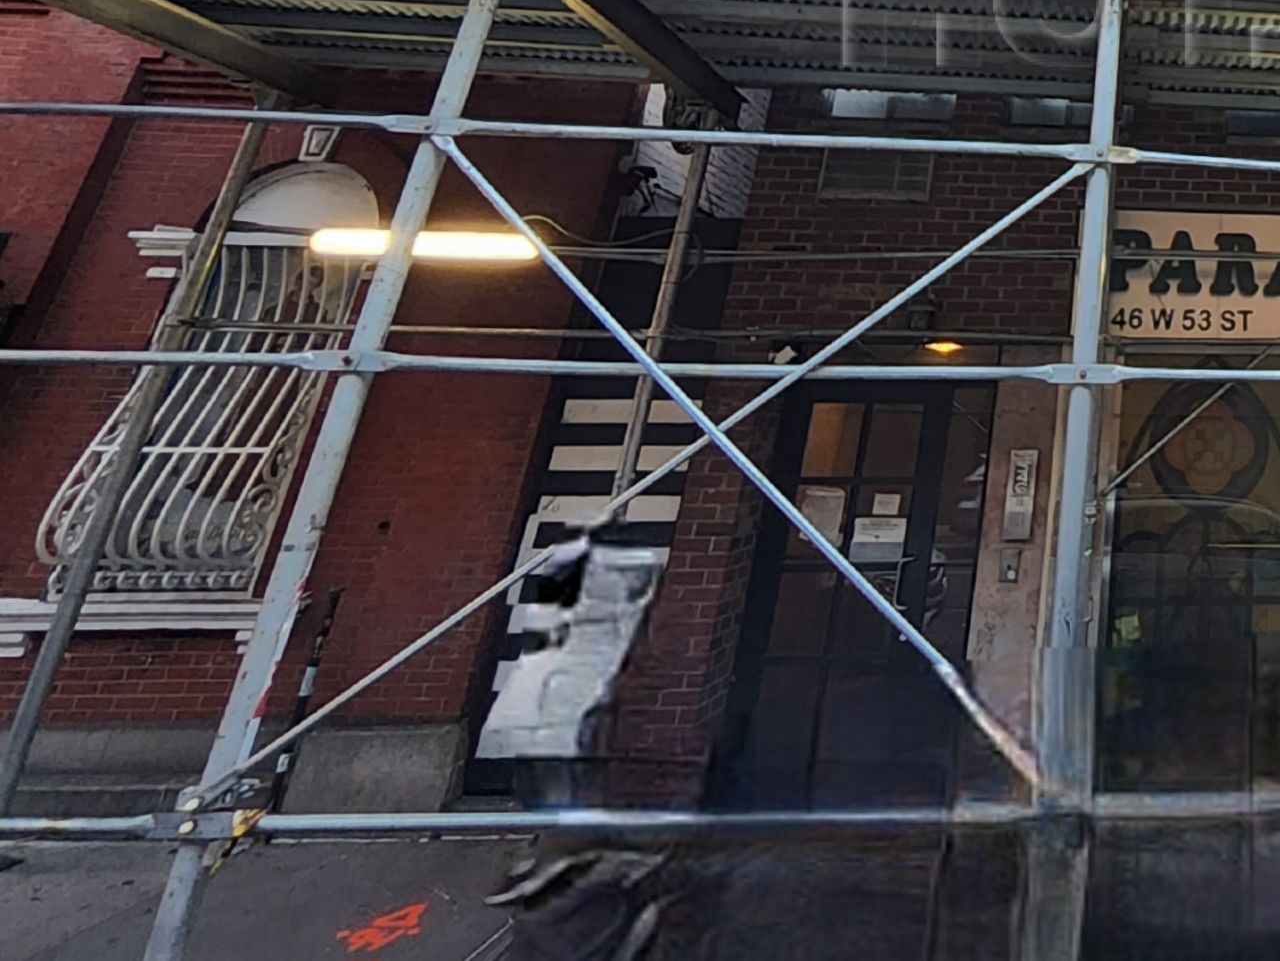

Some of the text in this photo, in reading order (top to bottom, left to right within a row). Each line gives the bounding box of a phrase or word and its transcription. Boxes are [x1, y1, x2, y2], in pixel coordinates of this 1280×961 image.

[1151, 308, 1174, 331] W
[1181, 309, 1212, 331] 53
[1220, 310, 1253, 332] ST
